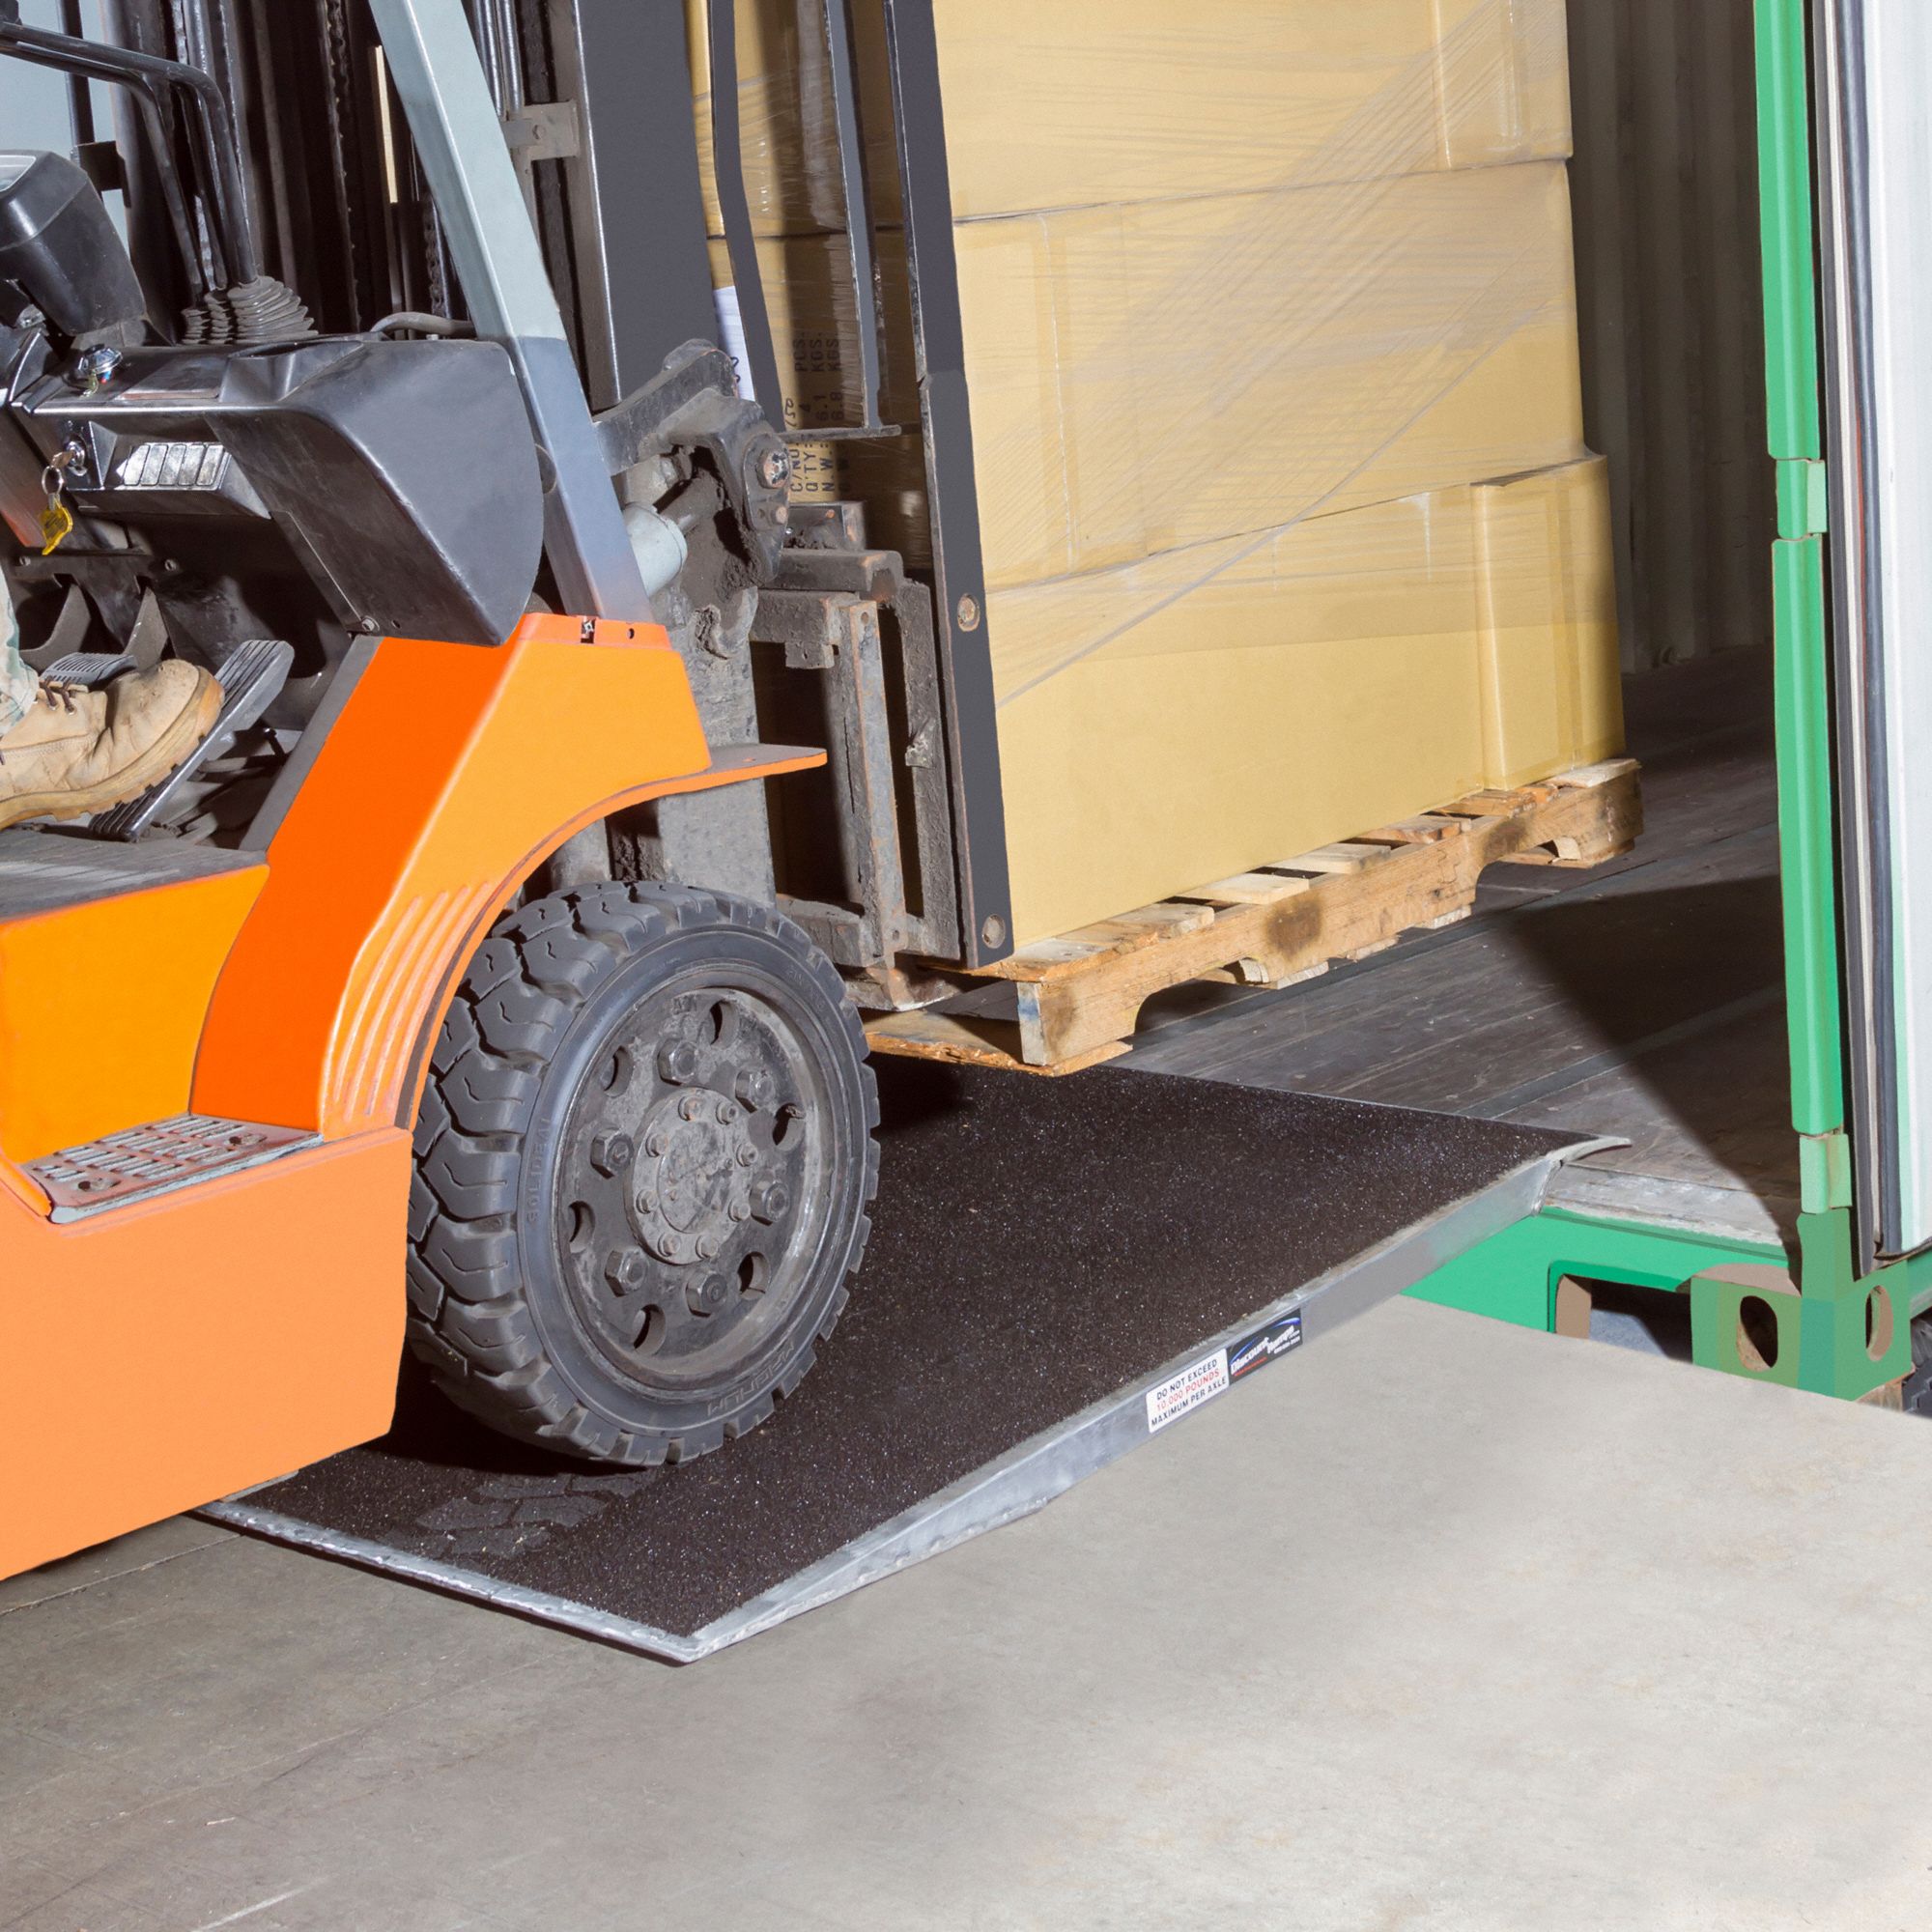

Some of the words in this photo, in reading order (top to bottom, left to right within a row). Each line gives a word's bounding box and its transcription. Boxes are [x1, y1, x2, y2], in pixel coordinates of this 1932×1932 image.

[1151, 1399, 1188, 1426] MAXIMUM
[1190, 1389, 1206, 1403] PER
[1208, 1376, 1226, 1393] AXLE
[1156, 1388, 1167, 1401] DO
[1170, 1378, 1185, 1392] NOT
[1187, 1359, 1217, 1382] EXCEED
[1185, 1368, 1219, 1393] POUNDS
